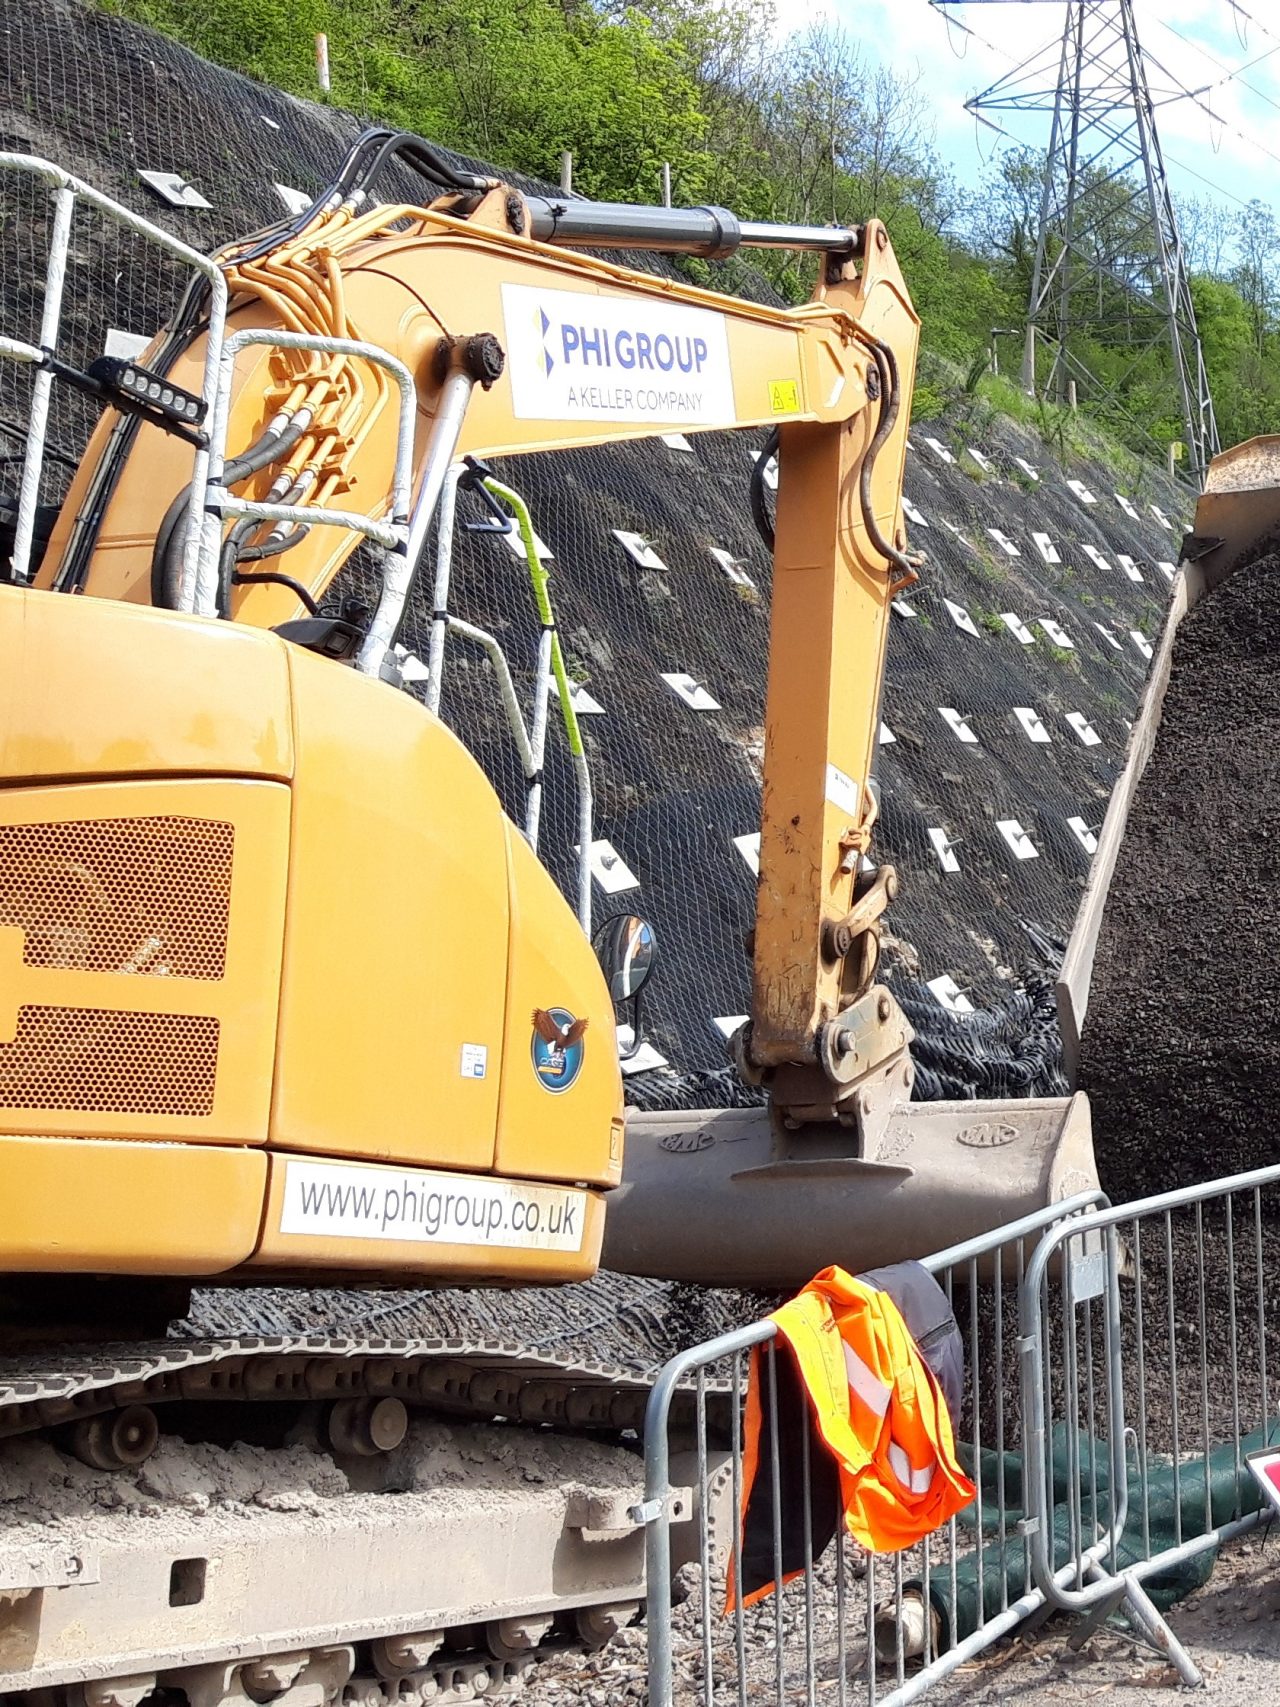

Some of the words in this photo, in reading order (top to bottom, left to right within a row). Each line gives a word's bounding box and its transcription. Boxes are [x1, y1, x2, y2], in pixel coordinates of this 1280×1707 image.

[568, 385, 579, 408] A
[580, 386, 634, 410] KELLER
[636, 388, 703, 412] COMPANY
[539, 1056, 565, 1068] CASE
[300, 1179, 576, 1239] www.phigroup.co.uk
